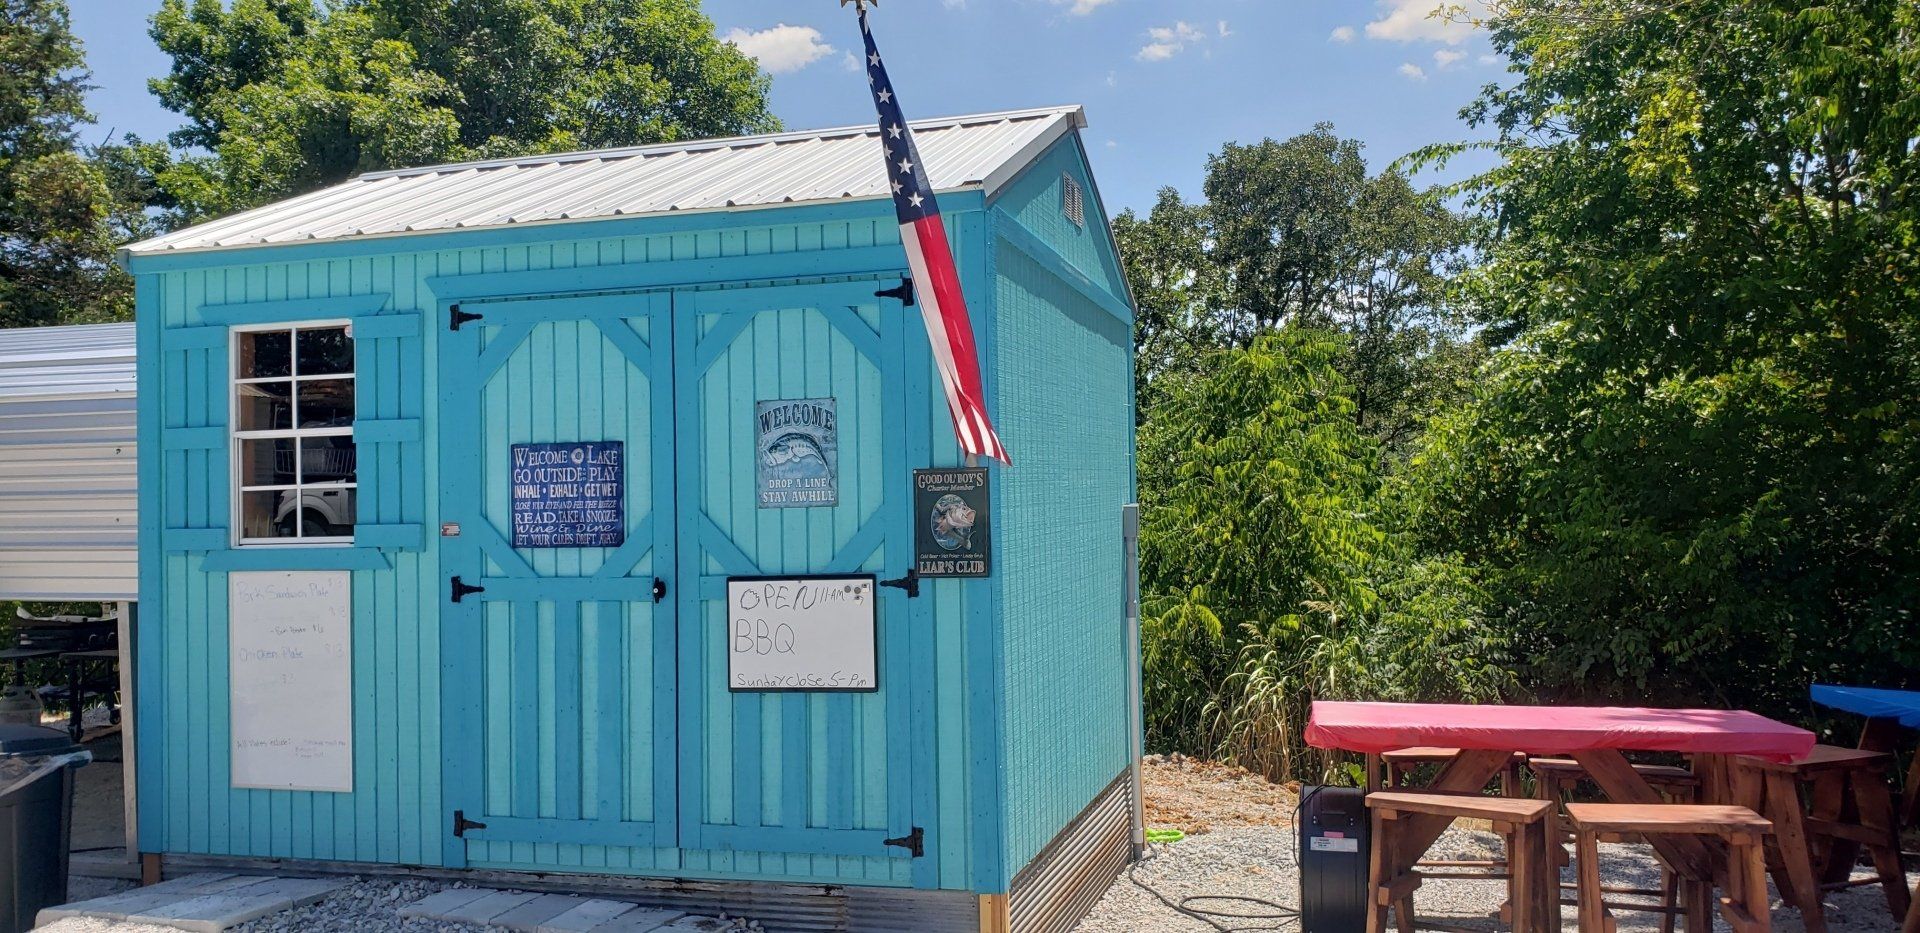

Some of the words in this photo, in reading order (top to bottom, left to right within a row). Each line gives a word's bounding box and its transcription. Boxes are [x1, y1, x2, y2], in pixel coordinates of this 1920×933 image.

[760, 403, 834, 434] WELCOME
[514, 447, 568, 467] WELCOME
[587, 445, 618, 465] LAKE
[514, 469, 531, 483] GO
[534, 467, 583, 482] OUTSIDE
[590, 467, 618, 481] PLAY
[918, 474, 943, 488] GOOD
[957, 472, 984, 487] BOY'S
[515, 484, 541, 499] INHALE
[550, 483, 578, 498] EXHALE
[584, 483, 600, 497] GET
[601, 483, 617, 497] WET
[769, 479, 793, 489] DROP
[796, 479, 802, 488] A
[805, 478, 827, 488] LINE
[763, 491, 788, 503] STAY
[792, 490, 835, 502] AWHILE
[514, 501, 531, 510] CLOSE
[560, 501, 573, 510] AND
[584, 500, 598, 509] THE
[559, 510, 579, 523] TAKE
[580, 510, 585, 522] A
[516, 524, 558, 533] Wine
[558, 524, 568, 533] &
[576, 523, 616, 533] Dine
[516, 534, 529, 545] LET
[531, 534, 550, 545] YOUR
[552, 533, 574, 545] CARES
[576, 533, 597, 545] DRIFT
[919, 560, 955, 574] LIAR'S
[956, 560, 985, 573] CLUB
[740, 583, 819, 611] OPEN
[735, 618, 796, 656] BBQ
